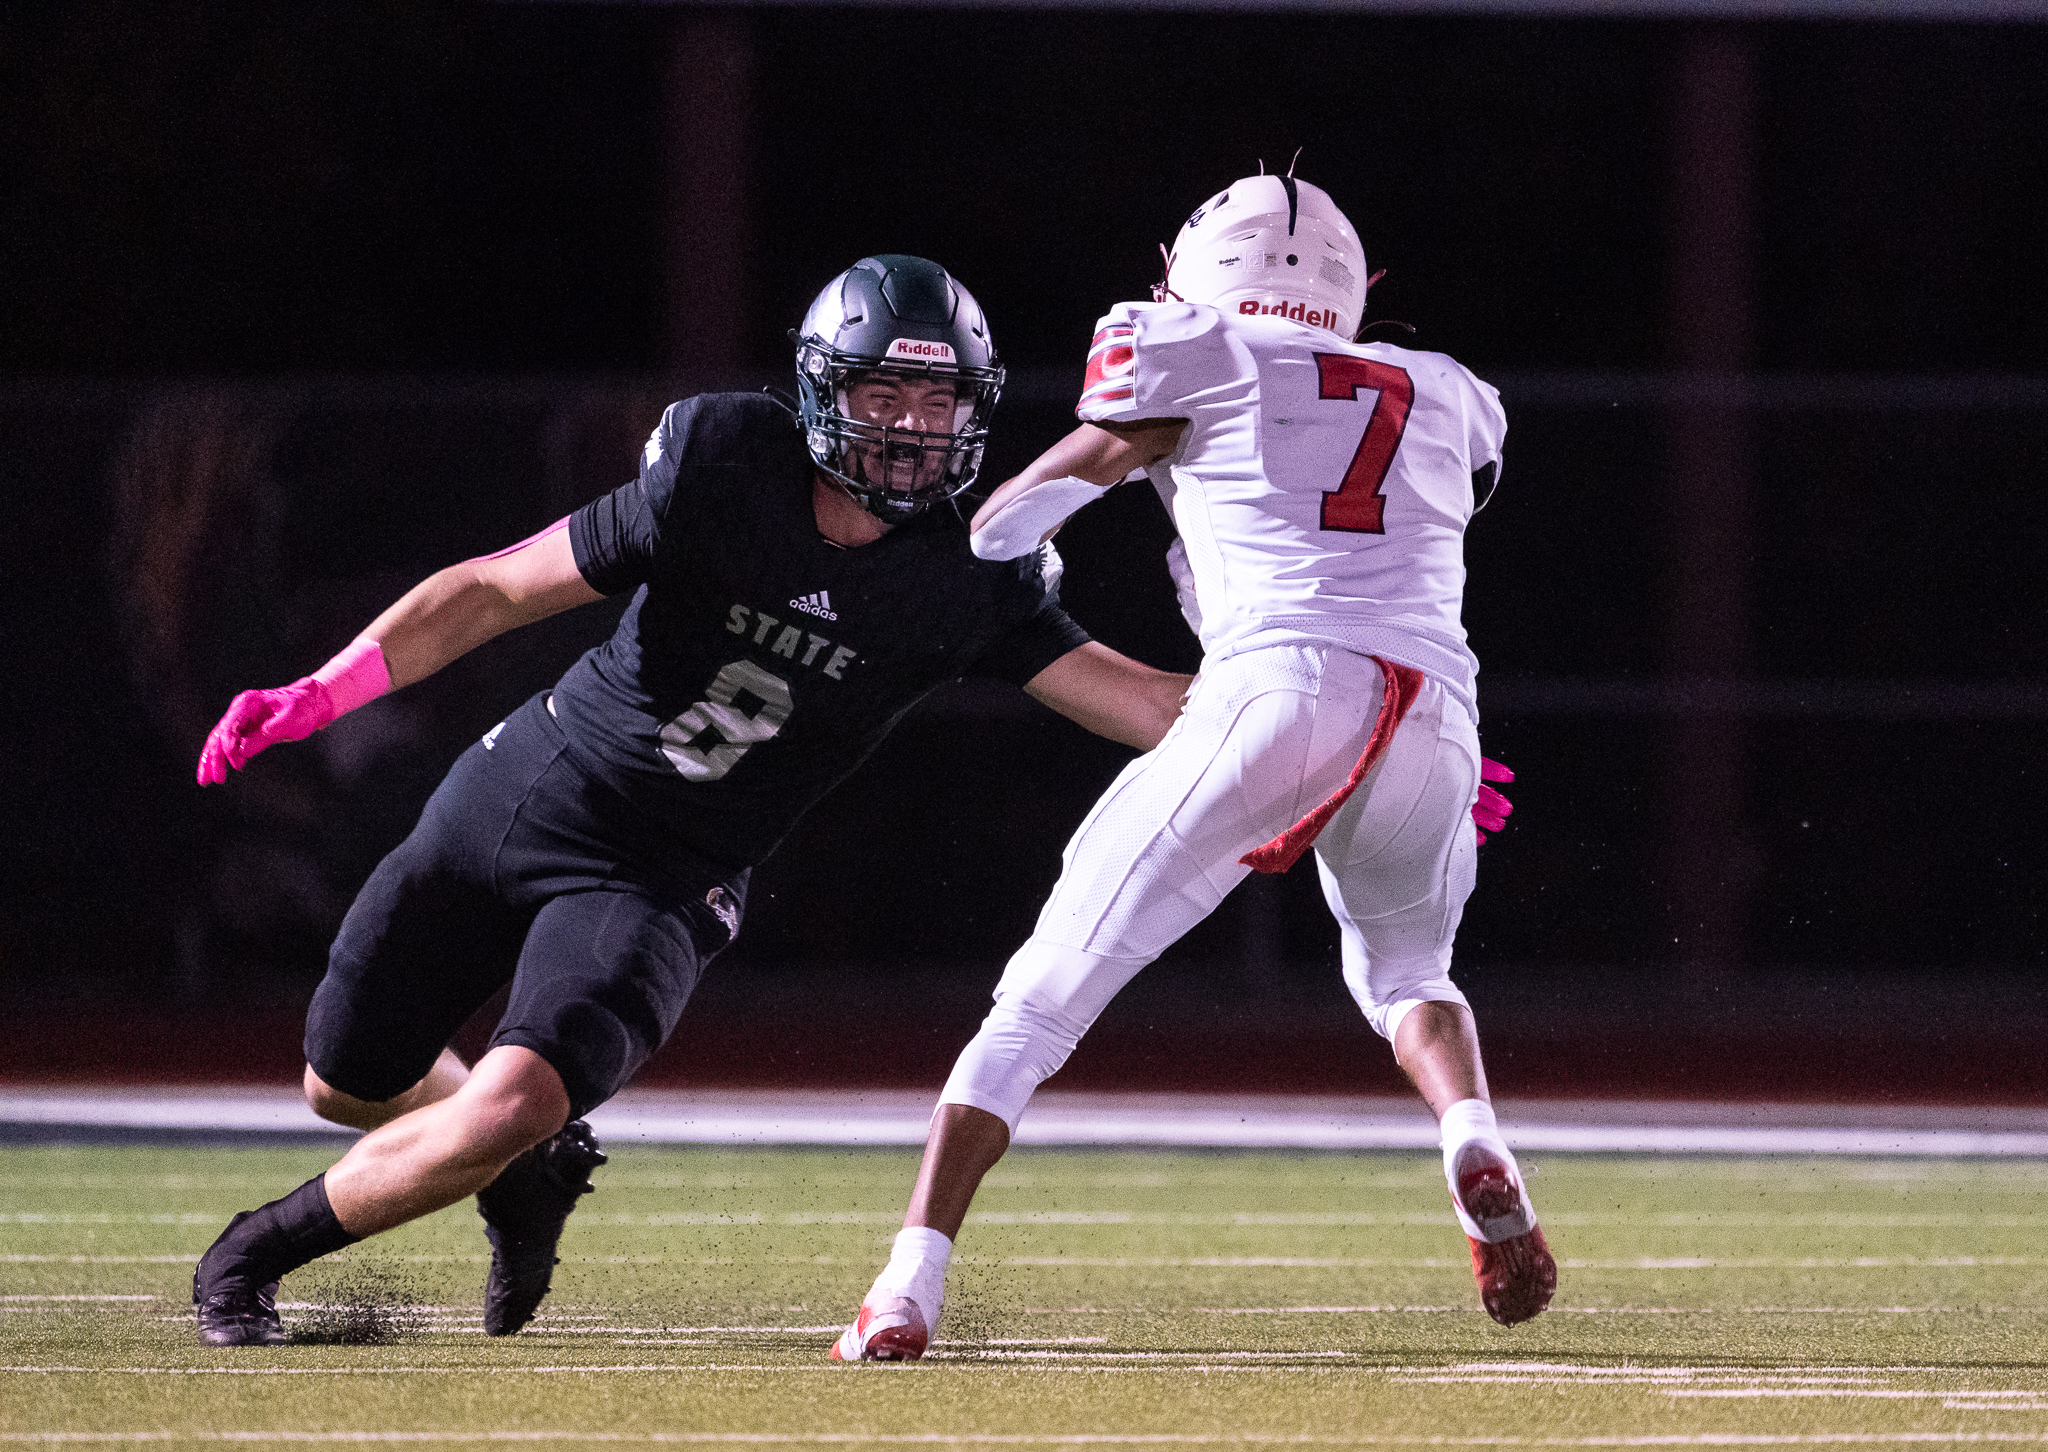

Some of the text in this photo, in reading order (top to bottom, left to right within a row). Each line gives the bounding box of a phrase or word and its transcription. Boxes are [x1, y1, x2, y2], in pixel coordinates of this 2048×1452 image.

[1239, 300, 1337, 330] Riddell
[898, 342, 949, 358] Riddell
[1312, 352, 1415, 535] 7
[789, 599, 838, 621] adidas
[726, 604, 857, 680] STATE
[660, 660, 794, 782] 8
